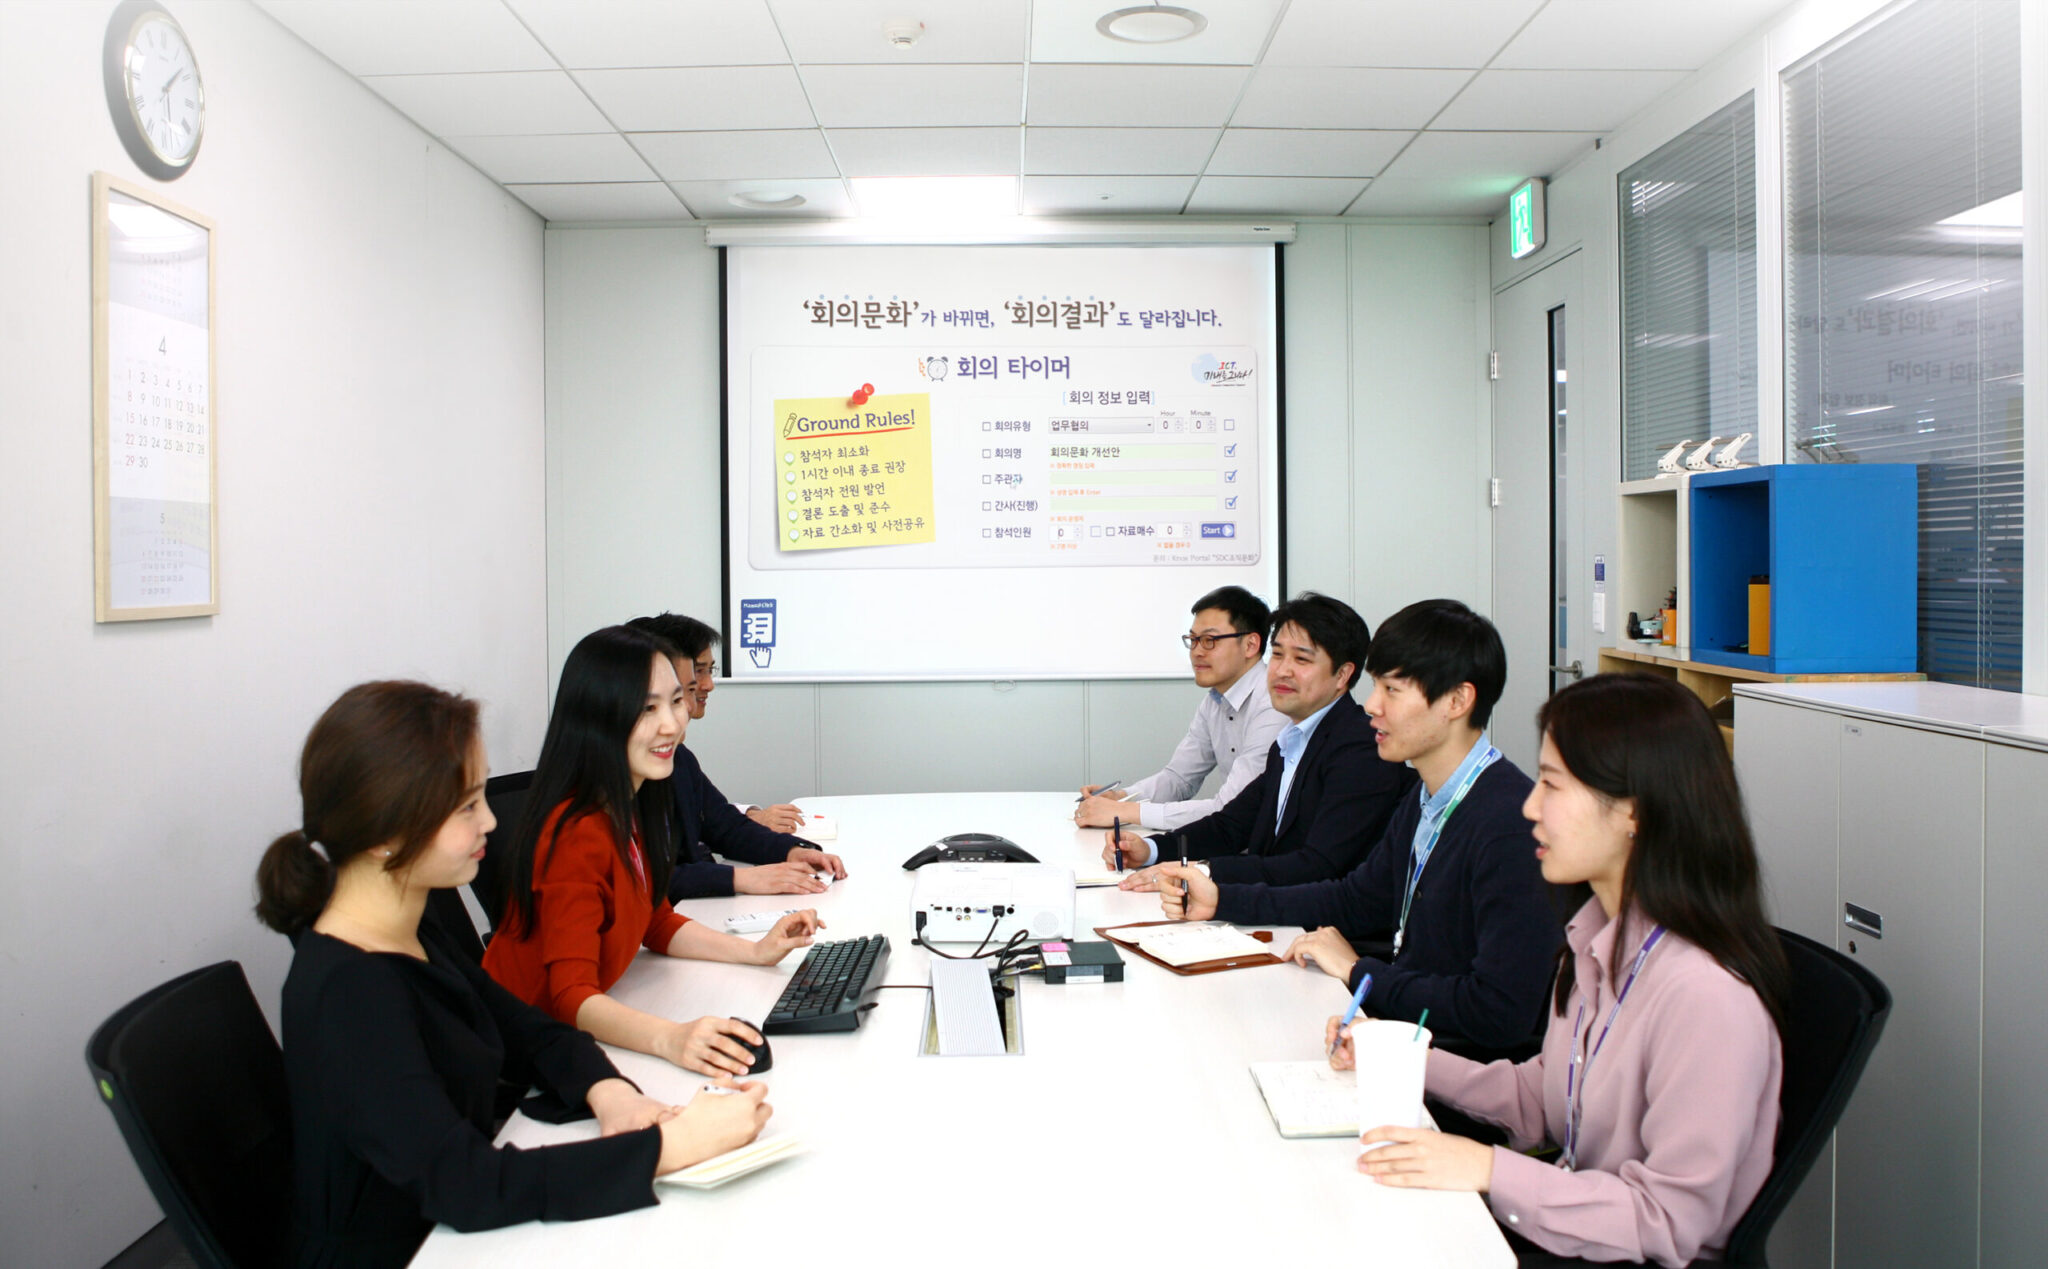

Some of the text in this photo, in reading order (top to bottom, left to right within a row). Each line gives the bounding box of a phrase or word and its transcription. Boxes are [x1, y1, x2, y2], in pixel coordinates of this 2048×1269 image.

[943, 309, 995, 329] 바뀌면,
[1139, 309, 1222, 329] 달라집니다.
[158, 336, 167, 356] 4
[957, 355, 1071, 379] 회의 타이머
[1098, 391, 1122, 405] 정보
[797, 409, 916, 432] Ground Rules!
[994, 421, 1031, 432] 회의유형
[1051, 420, 1089, 432] 업무협의
[1163, 421, 1169, 430] 0
[1196, 421, 1202, 430] 0
[800, 445, 870, 464] 참석자 최소화
[994, 447, 1022, 459] 회의명
[1050, 446, 1120, 458] 회의문화 개선안
[801, 460, 907, 480] 1시간 이내 종료 권장
[801, 482, 886, 502] 참석자 전원 발언
[802, 501, 891, 521] 결론 도출 및 준수
[994, 501, 1038, 512] 간사(진행)
[802, 516, 925, 540] 자료 간소화 및 사전공유
[994, 527, 1032, 539] 참석인원
[1118, 526, 1155, 537] 자료매수
[1167, 526, 1173, 535] 0
[1202, 526, 1221, 535] Start
